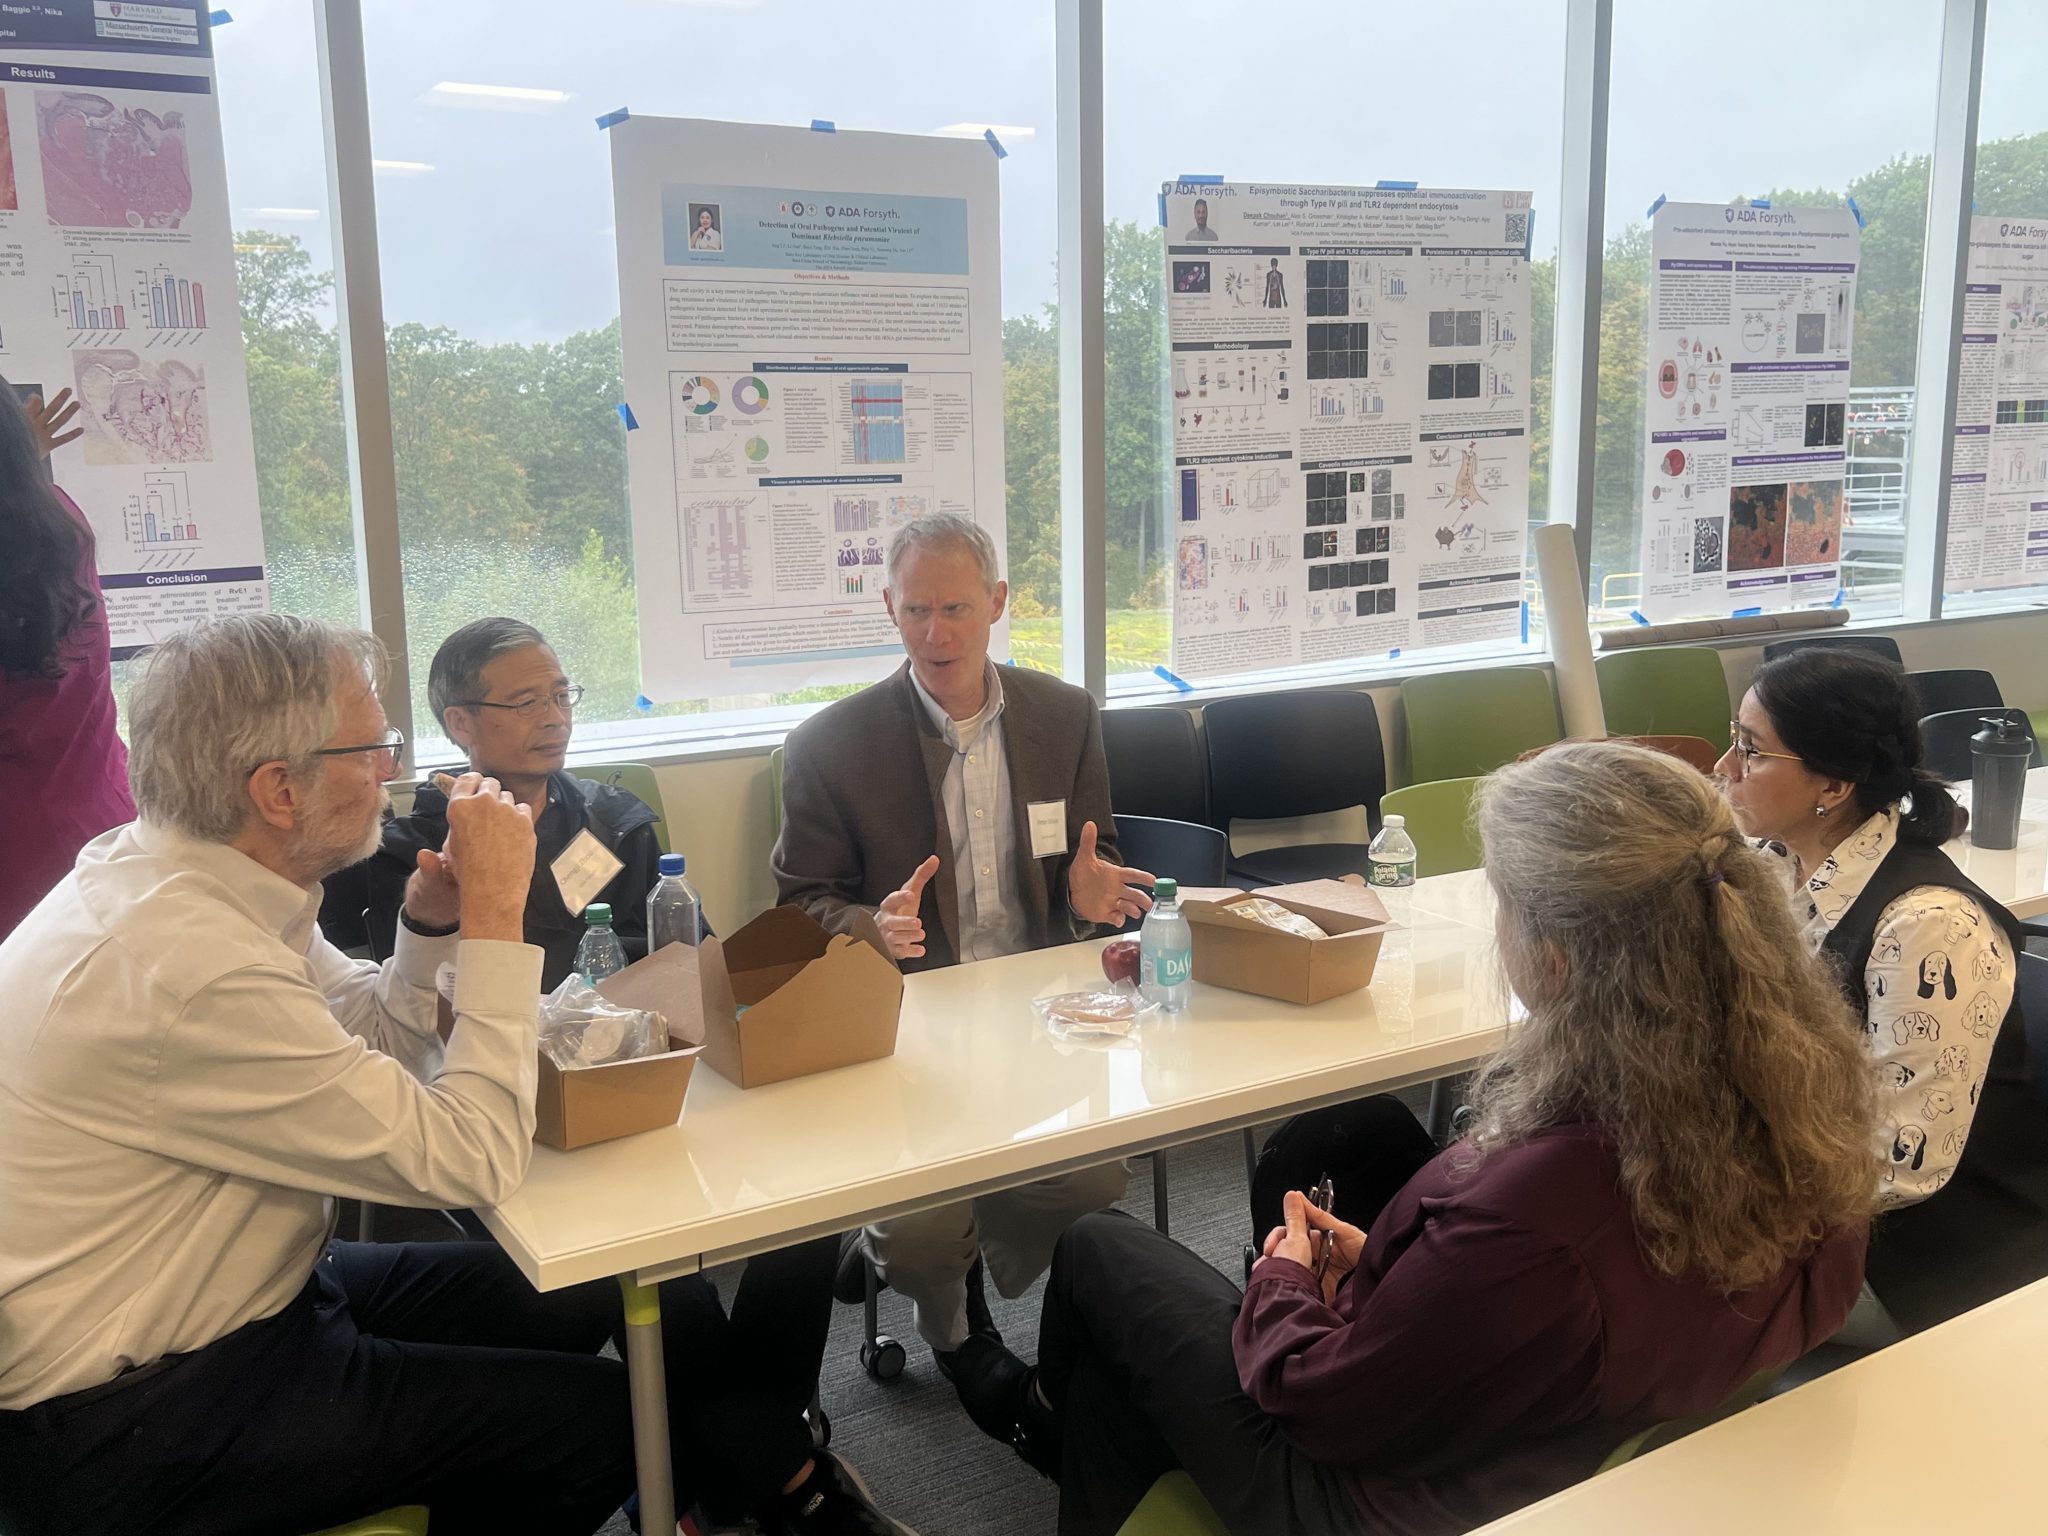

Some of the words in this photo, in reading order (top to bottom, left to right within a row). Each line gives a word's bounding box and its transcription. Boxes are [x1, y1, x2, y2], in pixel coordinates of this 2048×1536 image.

[2, 4, 31, 14] Baggio
[44, 8, 63, 16] Nika
[105, 21, 149, 32] Massachusetts
[150, 25, 172, 34] General
[11, 66, 56, 79] Results
[1175, 186, 1197, 196] ADA
[1249, 186, 1297, 196] Episymbiotic
[1298, 187, 1356, 197] Saccharibacteria
[1357, 190, 1396, 199] suppresses
[1397, 190, 1428, 200] epithelial
[1428, 191, 1487, 200] immunoactivation
[1280, 198, 1309, 209] through
[1310, 199, 1327, 209] Type
[1328, 199, 1336, 207] IV
[1337, 199, 1348, 209] pili
[1363, 201, 1381, 209] TLR2
[1382, 202, 1418, 210] dependent
[1419, 202, 1459, 211] endocytosis
[838, 207, 861, 217] ADA
[1736, 211, 1757, 222] ADA
[759, 220, 789, 229] Detection
[797, 222, 812, 230] Oral
[813, 223, 845, 233] Pathogens
[791, 232, 821, 240] Dominant
[823, 233, 853, 241] Klebsiella
[2009, 225, 2027, 237] ADA
[2028, 226, 2048, 241] Forsy
[1207, 247, 1253, 255] Saccharibacteria
[1306, 248, 1319, 256] Type
[1213, 343, 1250, 351] Methodology
[1201, 456, 1230, 464] dependent
[1231, 454, 1254, 462] cytokine
[146, 573, 208, 585] Conclusion
[1373, 864, 1398, 873] Poland
[1374, 871, 1398, 882] Spring
